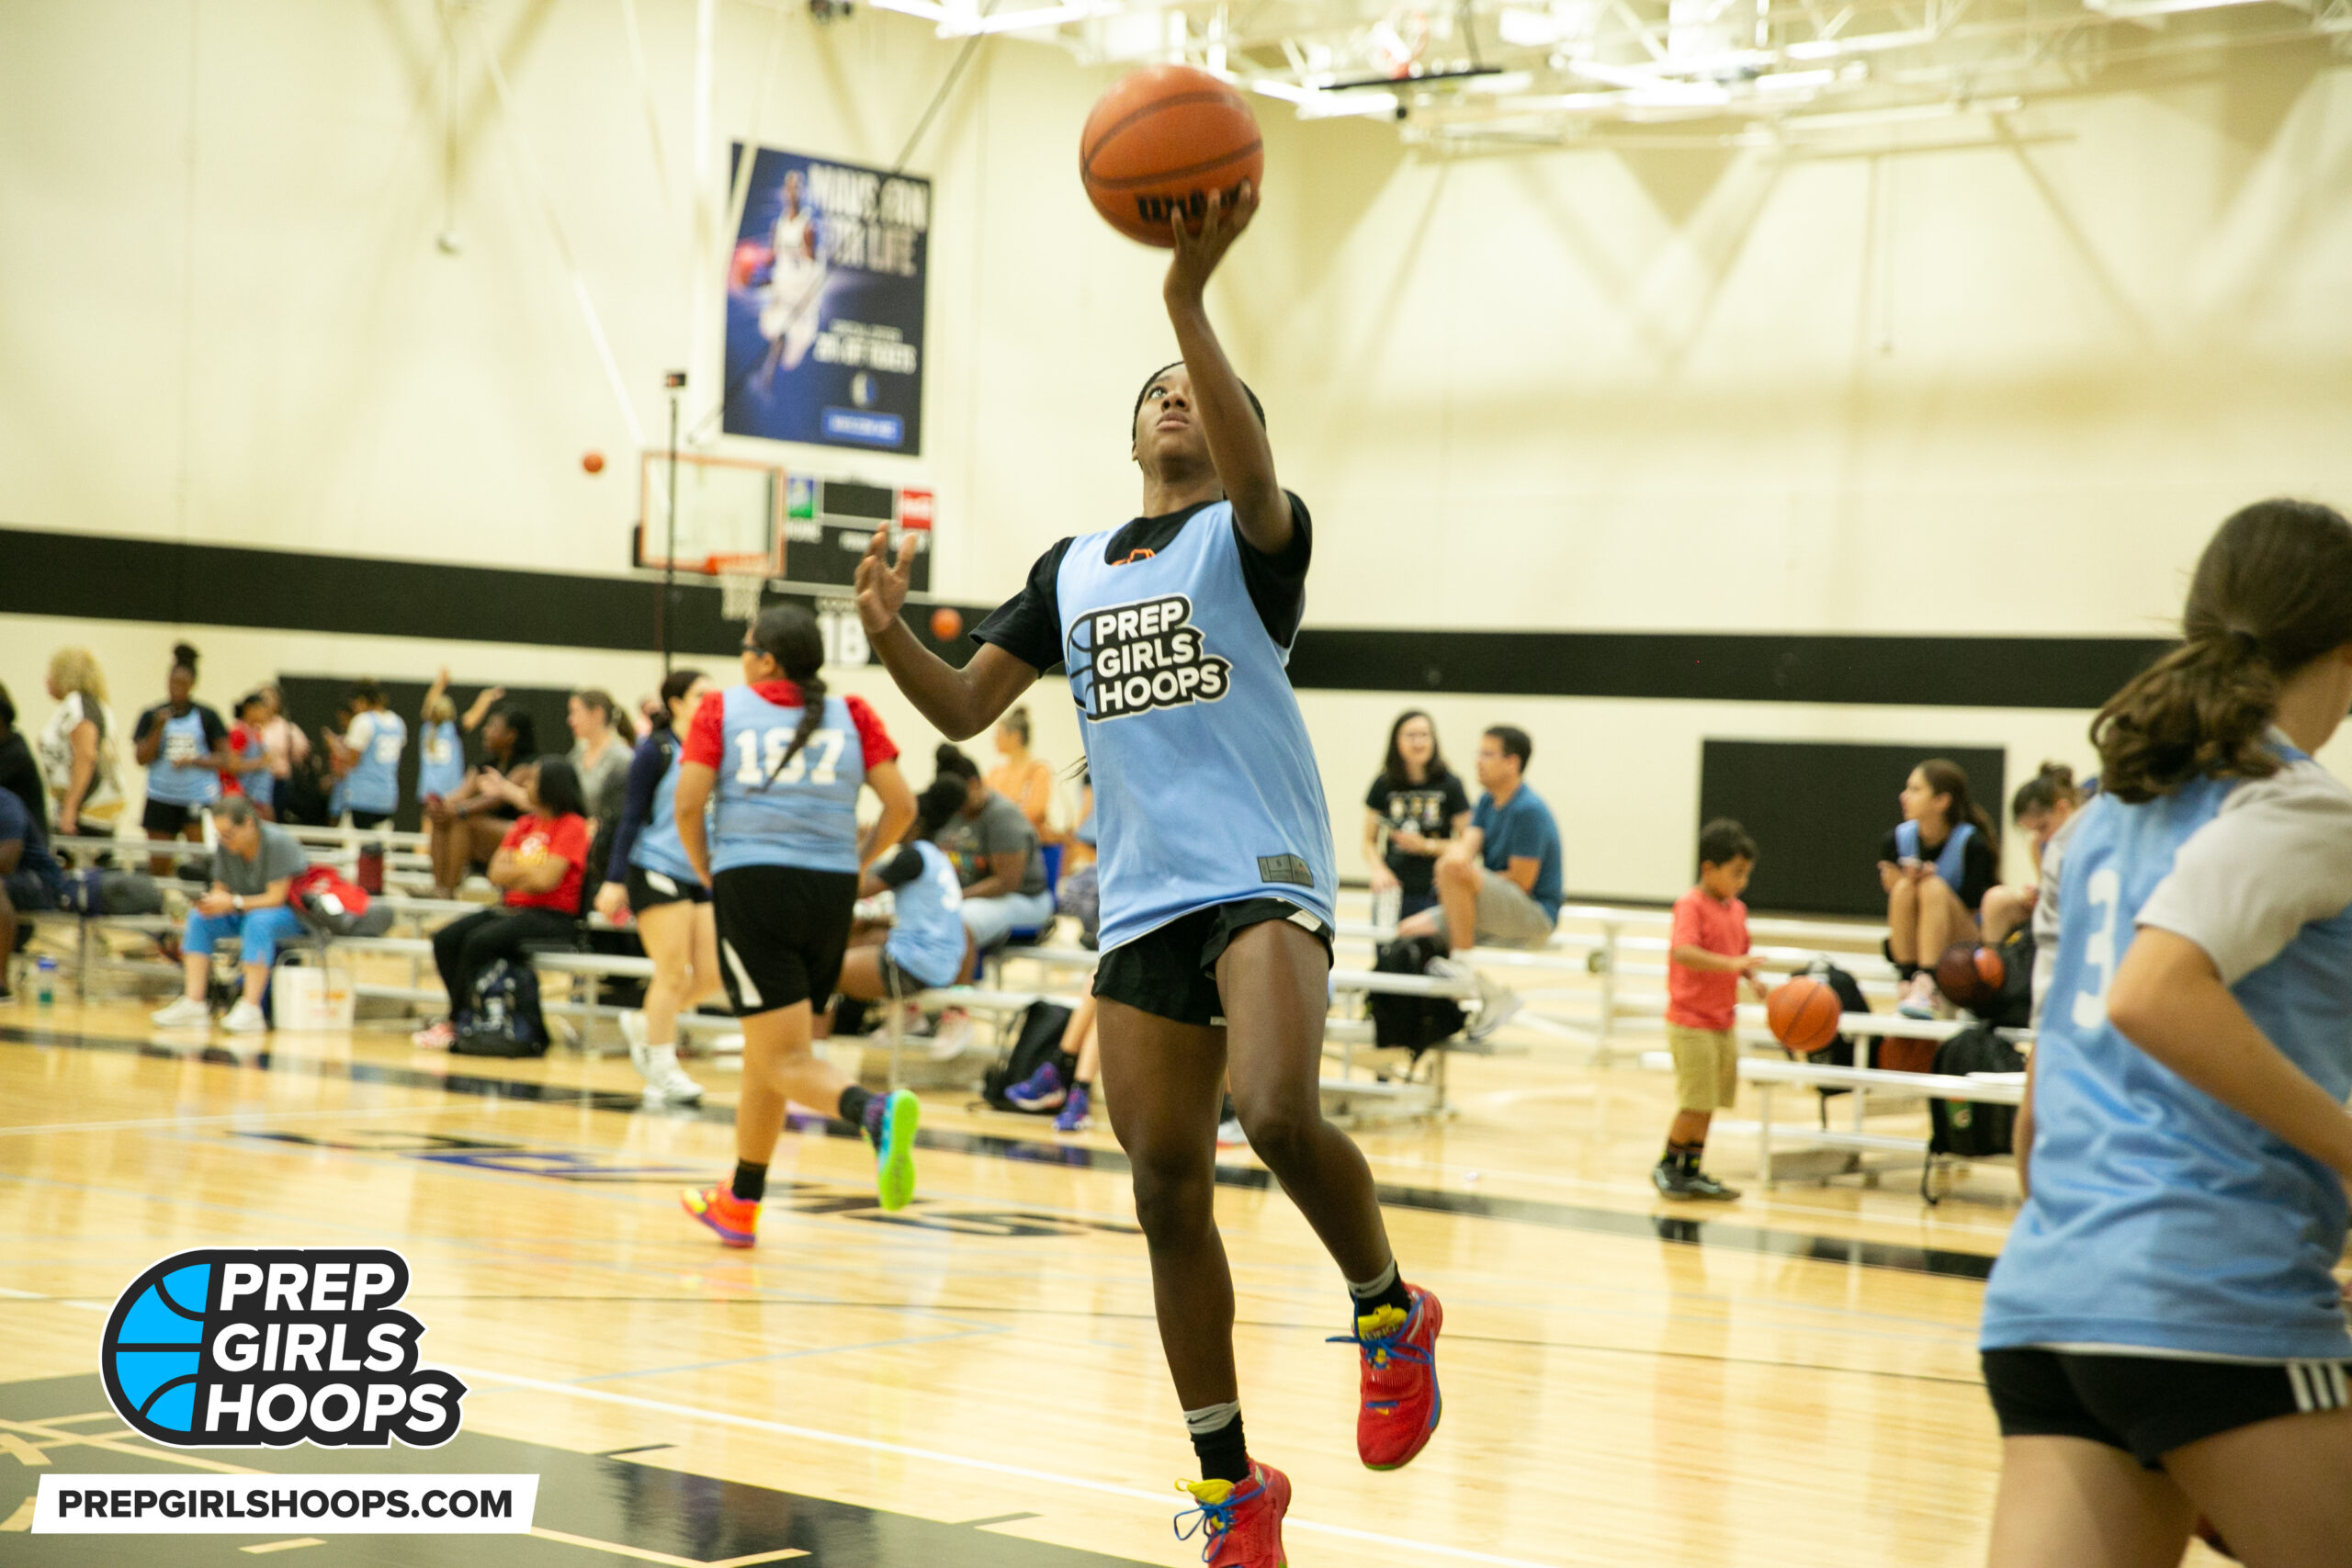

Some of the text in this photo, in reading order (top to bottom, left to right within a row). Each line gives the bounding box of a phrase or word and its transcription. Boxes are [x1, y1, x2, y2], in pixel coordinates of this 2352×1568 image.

[1095, 600, 1183, 645] PREP
[1096, 632, 1195, 679] GIRLS
[1098, 662, 1222, 713] HOOPS
